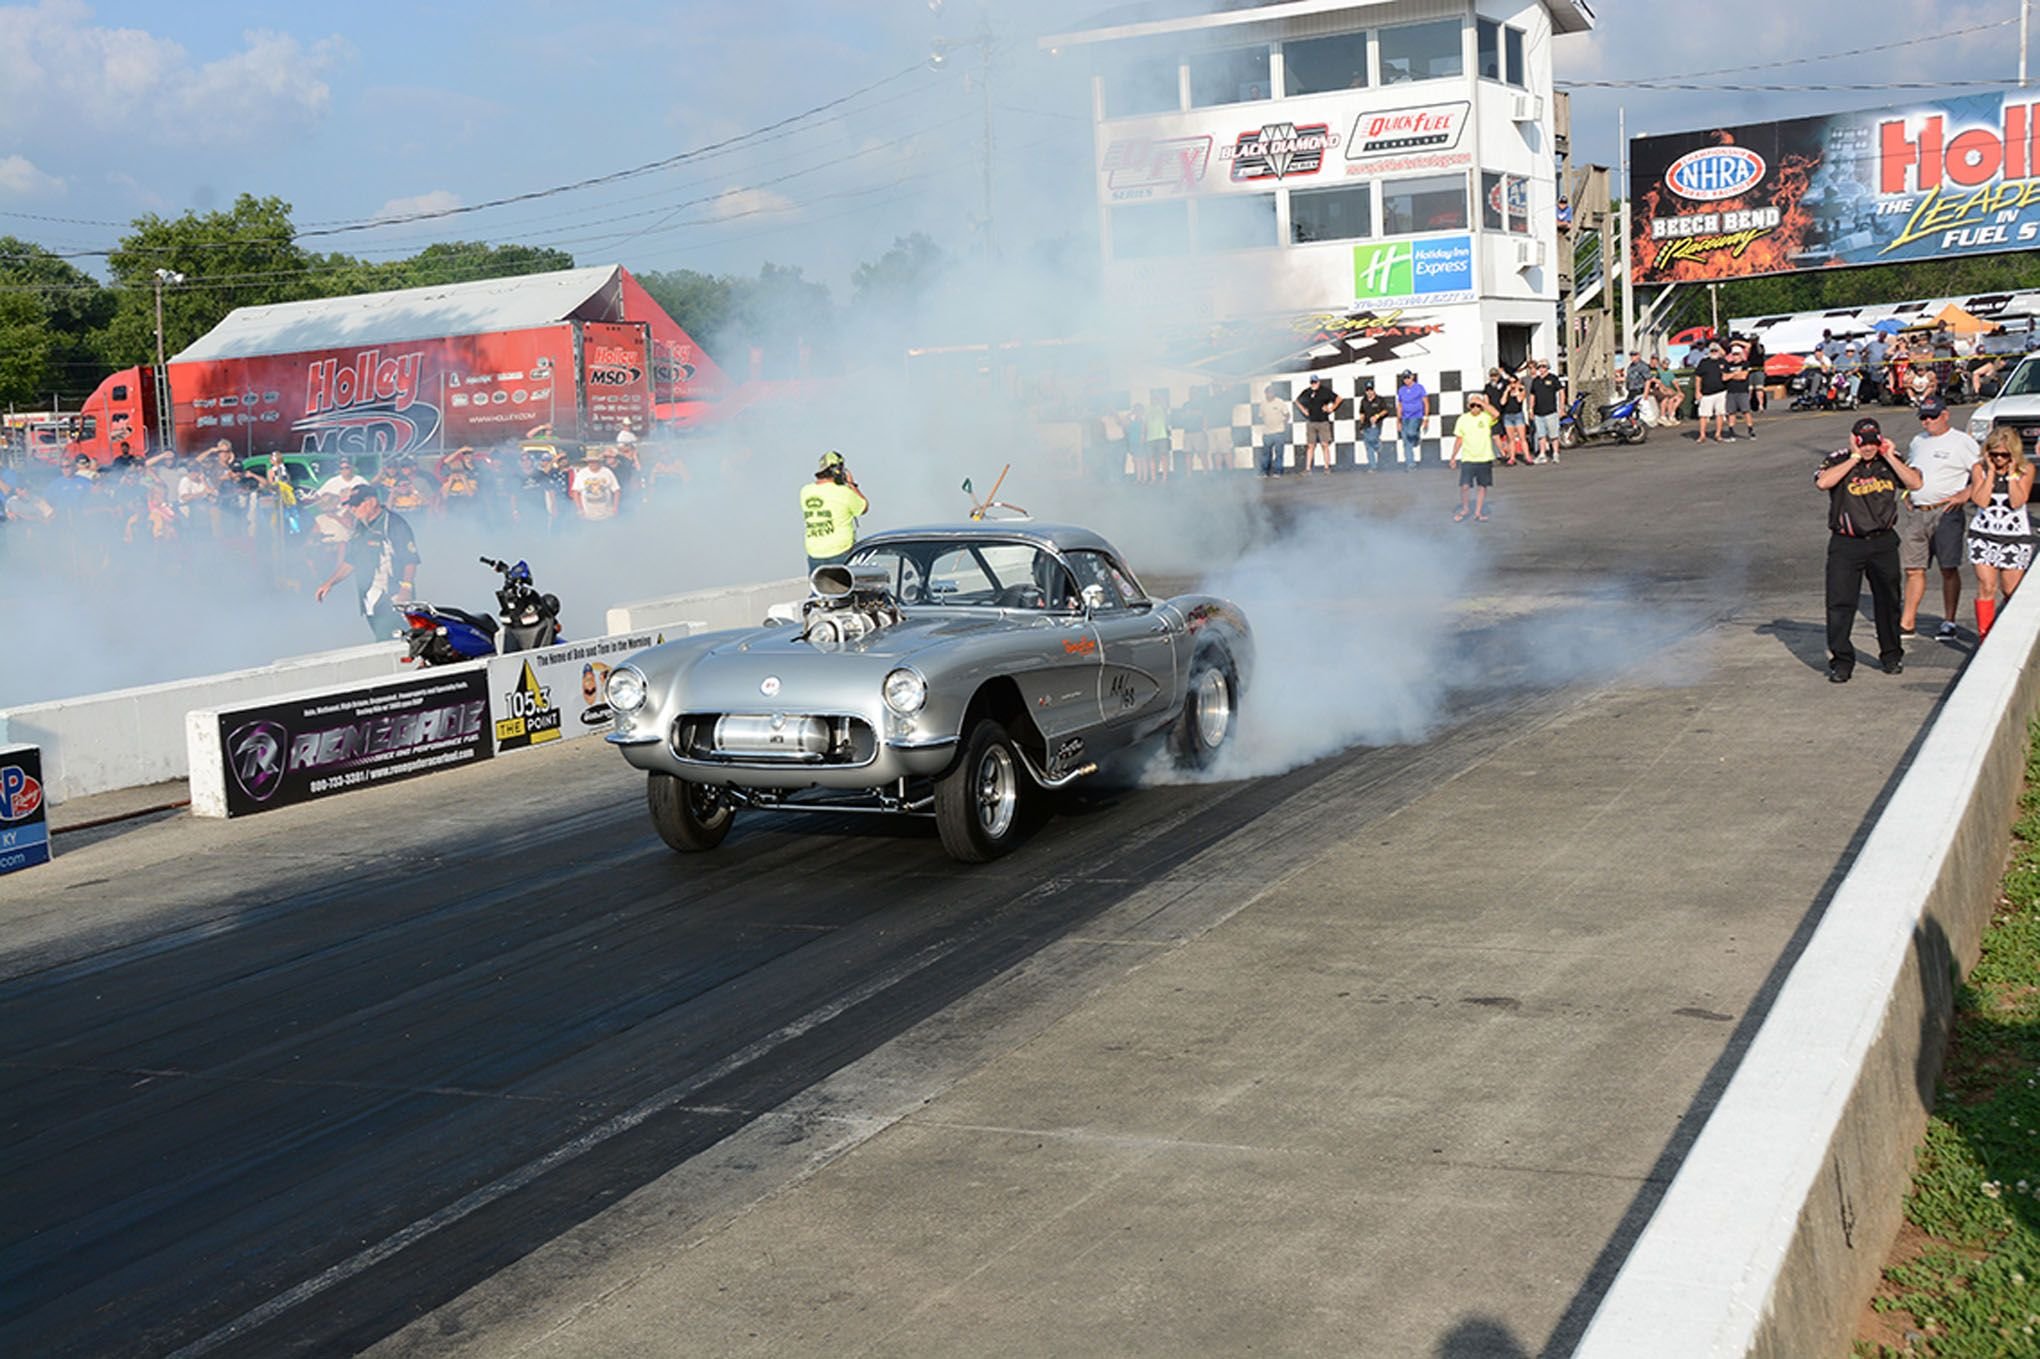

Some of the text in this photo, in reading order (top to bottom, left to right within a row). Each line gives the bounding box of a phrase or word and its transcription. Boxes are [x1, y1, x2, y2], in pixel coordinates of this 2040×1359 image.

[1219, 133, 1340, 161] BLACK DIAMOND
[1682, 156, 1750, 189] NHRA
[1876, 199, 1914, 216] THE
[1995, 208, 2020, 224] IN
[1651, 206, 1780, 240] BEECH BEND
[1659, 228, 1773, 270] Raceway
[1941, 225, 2009, 249] FUEL
[1414, 246, 1469, 261] Holiday Inn
[1415, 259, 1468, 277] Express
[1290, 309, 1403, 333] Bend
[1364, 322, 1445, 339] PARK
[593, 345, 639, 366] Holley
[305, 349, 424, 415] Holley
[590, 369, 627, 386] MSD
[300, 420, 399, 455] MSD
[536, 636, 652, 667] The Home of Bob and Tom in the Morning
[504, 685, 551, 720] 105.3
[289, 700, 486, 771] RENEGADE
[500, 712, 559, 735] THE POINT
[413, 738, 462, 754] PERFORMANCE
[2, 831, 17, 847] KY
